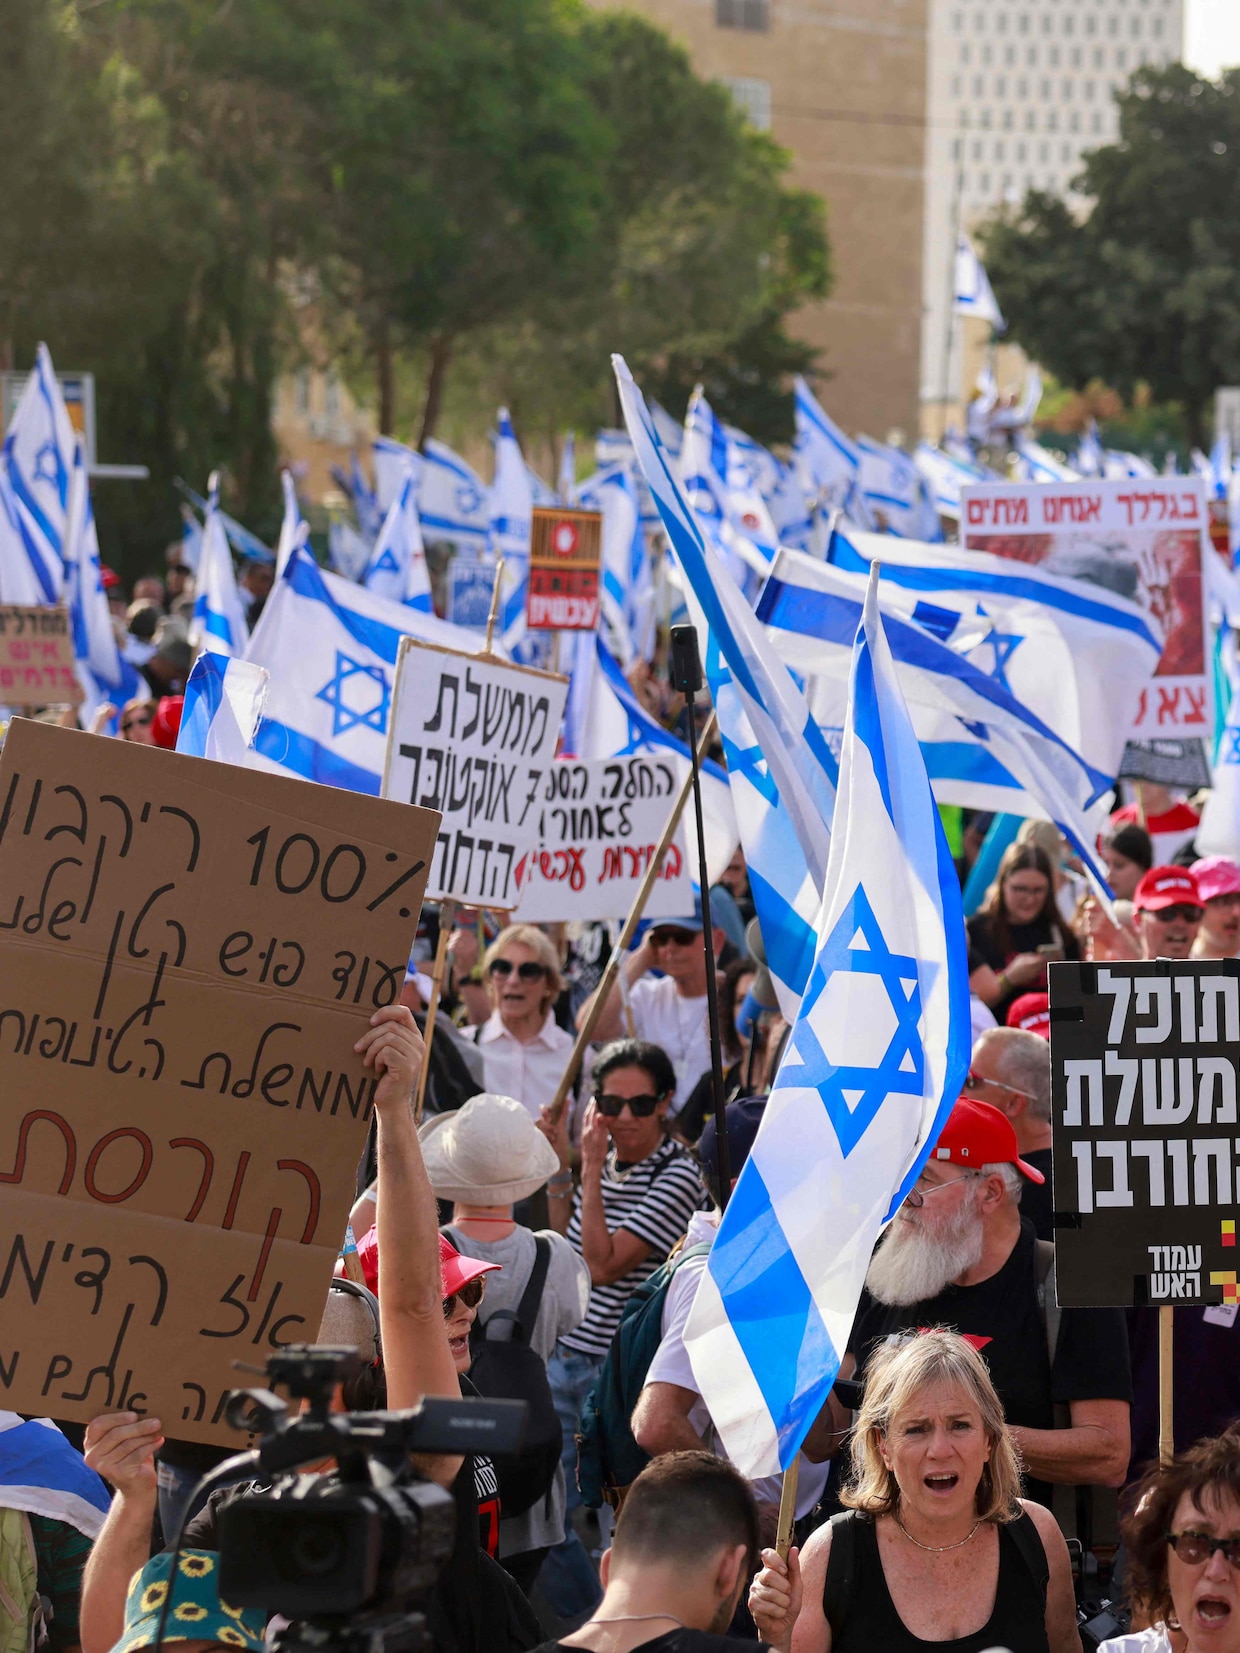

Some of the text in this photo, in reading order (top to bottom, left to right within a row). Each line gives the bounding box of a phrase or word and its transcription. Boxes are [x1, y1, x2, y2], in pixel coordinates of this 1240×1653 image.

[967, 489, 1199, 526] בגללך אנחנו מתים
[424, 667, 549, 757] ממשלת
[400, 743, 542, 828] 7 אוקטובר
[602, 758, 674, 799] החלה
[0, 857, 83, 941] שלנ
[247, 826, 425, 917] 100%
[527, 847, 586, 892] עכשי
[94, 883, 187, 1026] קטן
[331, 951, 406, 1008] עוד
[1097, 969, 1240, 1045] תופל
[0, 1109, 321, 1302] קורסת
[1148, 1245, 1203, 1272] עמוד
[1150, 1271, 1201, 1299] האש
[0, 1234, 168, 1378] קדימ
